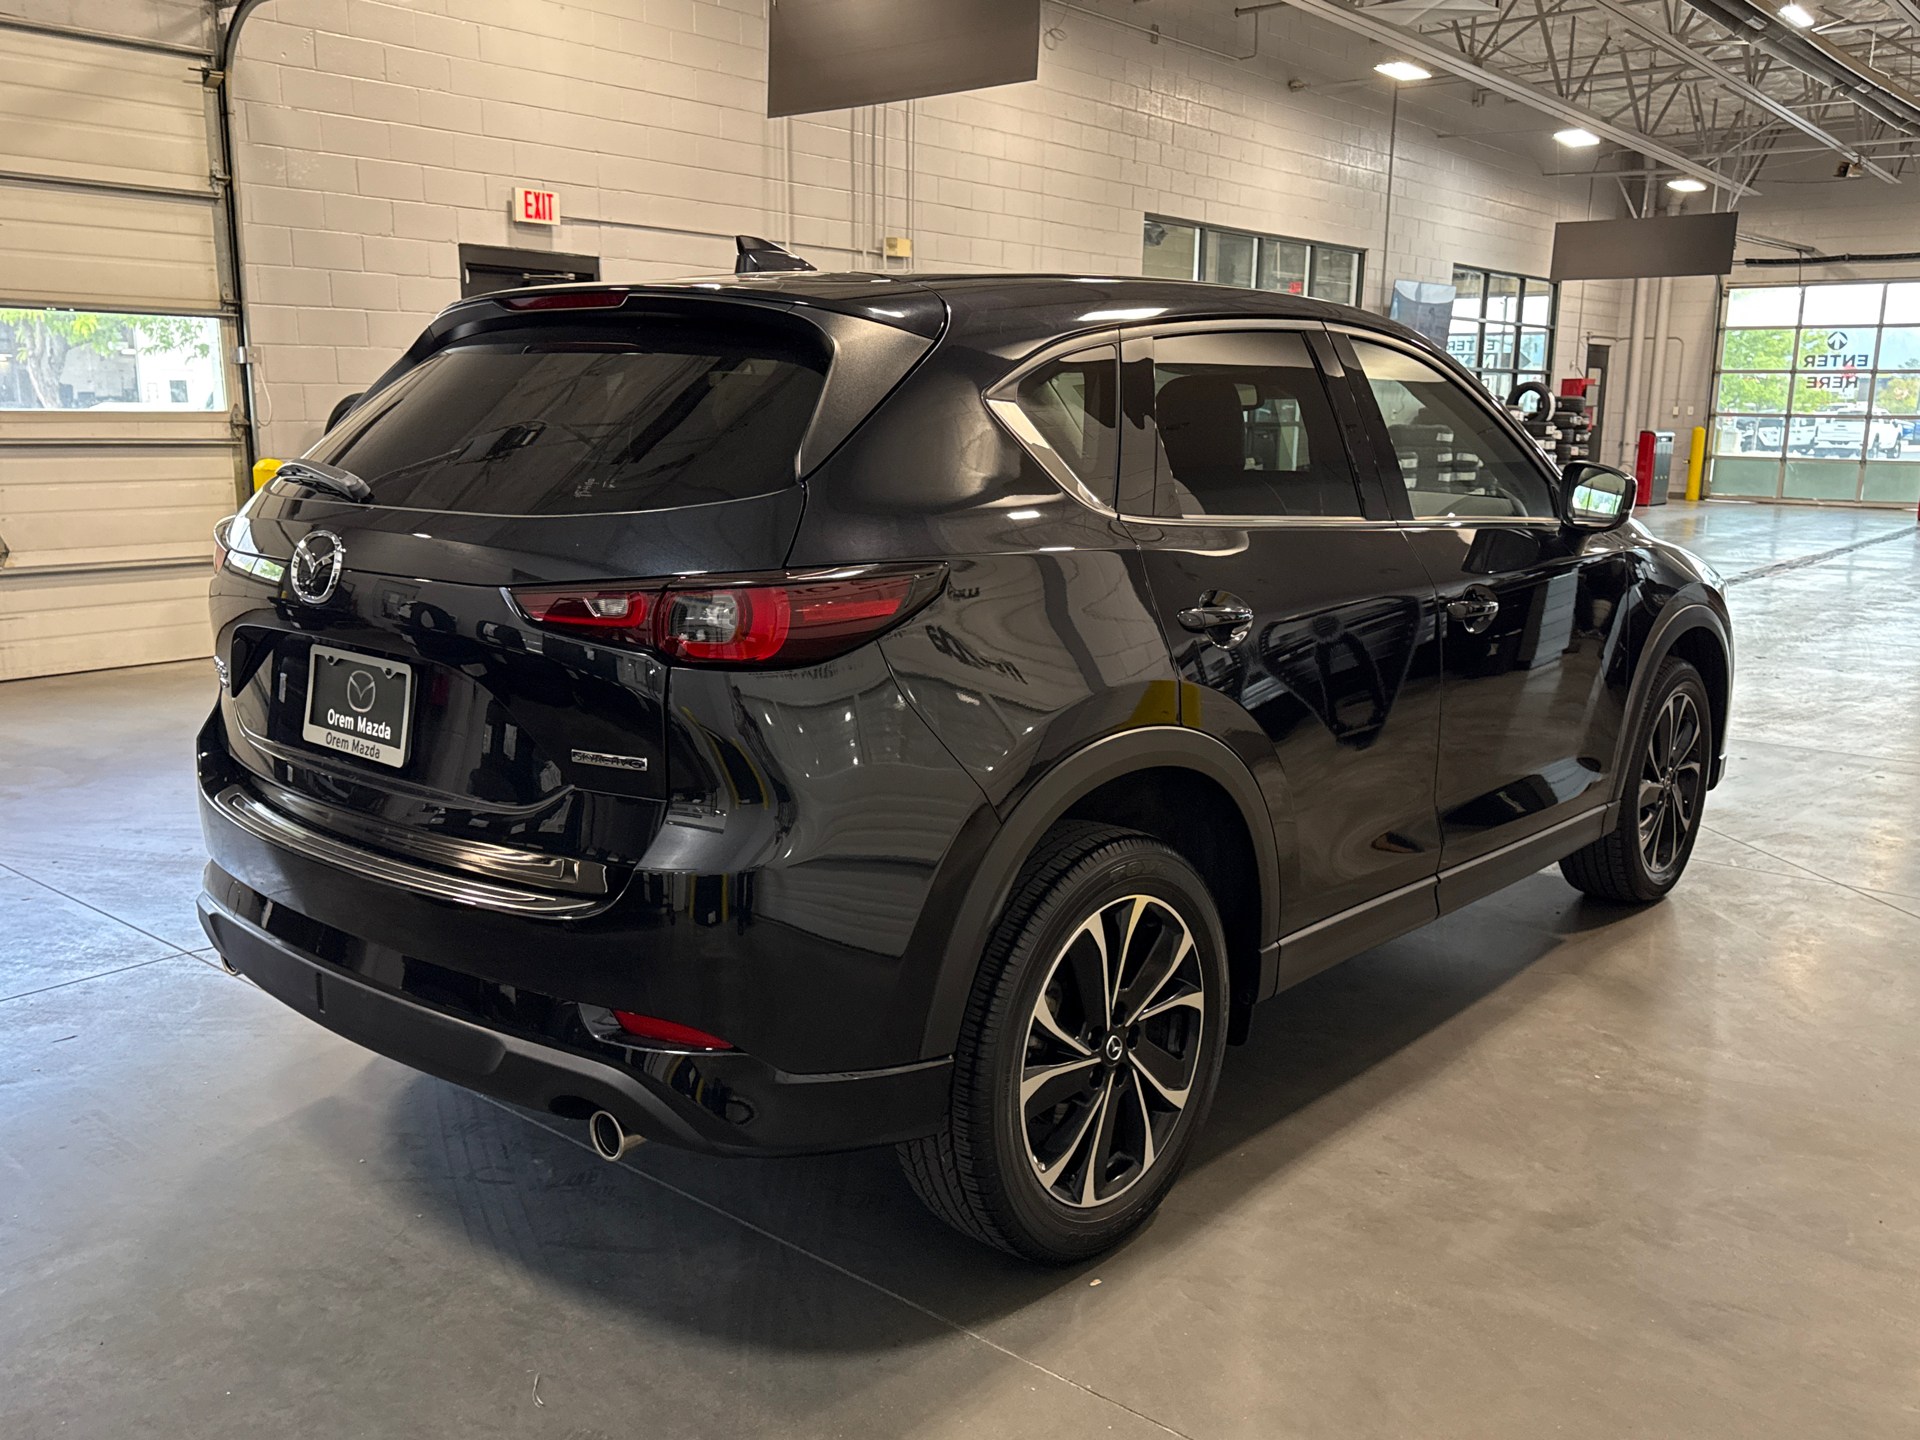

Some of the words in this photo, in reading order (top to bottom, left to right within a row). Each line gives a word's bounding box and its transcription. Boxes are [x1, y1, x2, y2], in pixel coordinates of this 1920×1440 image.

[524, 190, 554, 221] EXIT
[327, 709, 354, 730] Orem
[357, 716, 391, 740] Mazda
[326, 732, 349, 750] Orem
[351, 739, 381, 759] Mazda
